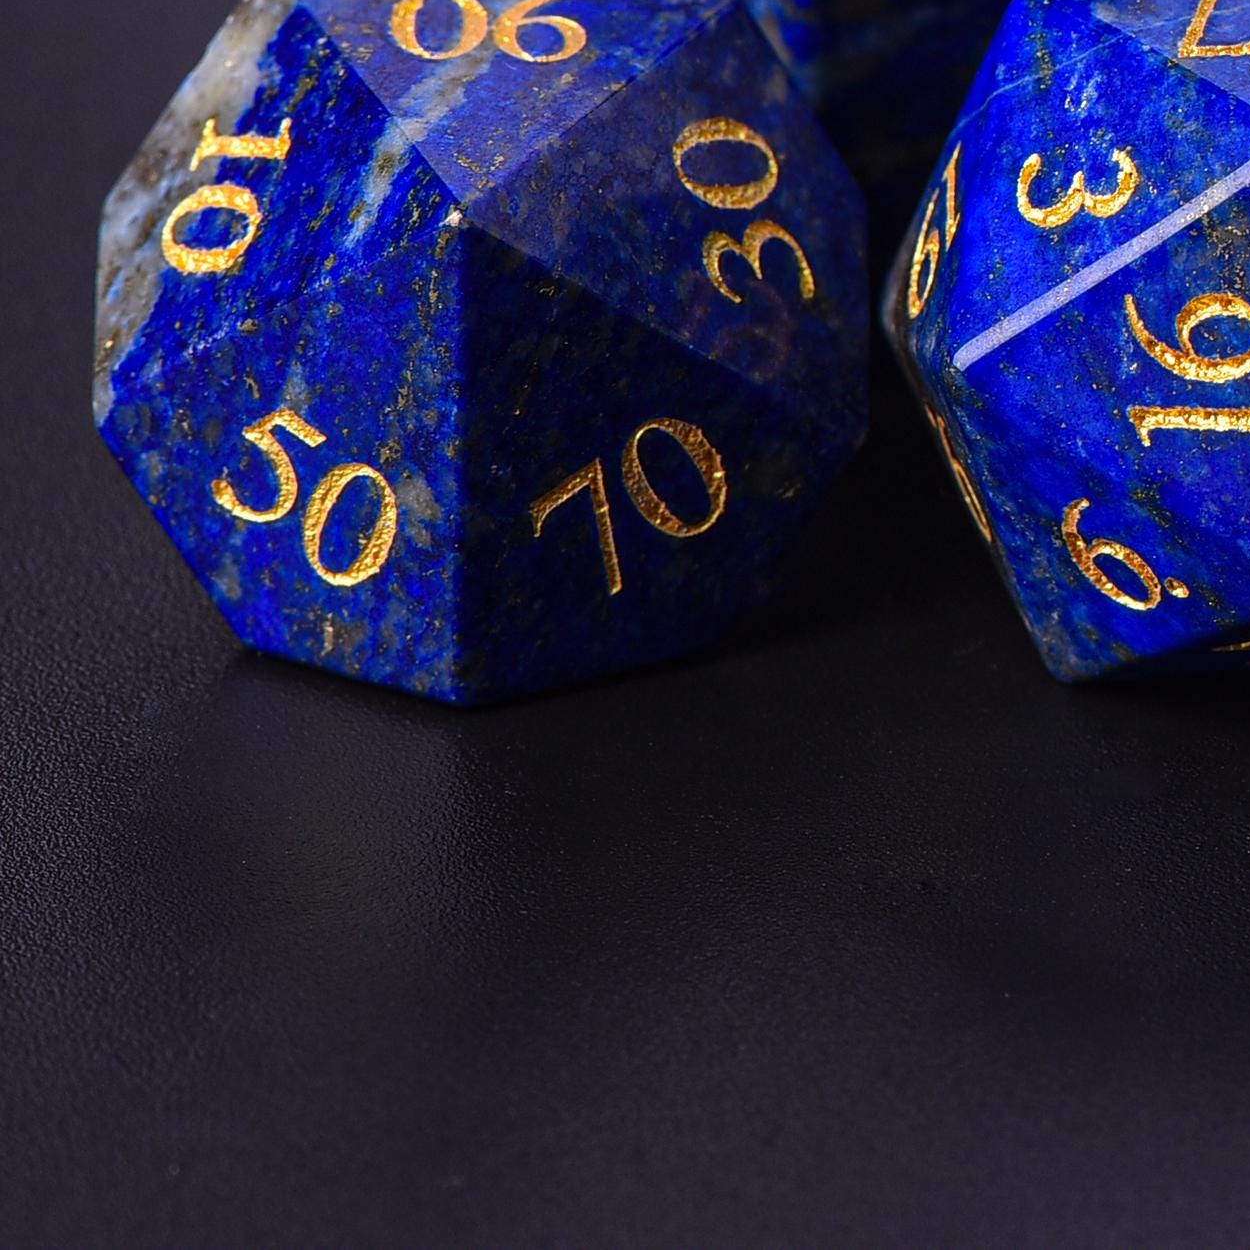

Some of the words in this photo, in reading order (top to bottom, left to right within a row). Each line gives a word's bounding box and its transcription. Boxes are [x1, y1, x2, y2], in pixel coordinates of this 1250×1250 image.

[161, 117, 293, 275] 10
[671, 116, 816, 305] 30
[1016, 147, 1139, 229] 3
[210, 407, 398, 588] 50
[528, 416, 728, 598] 70
